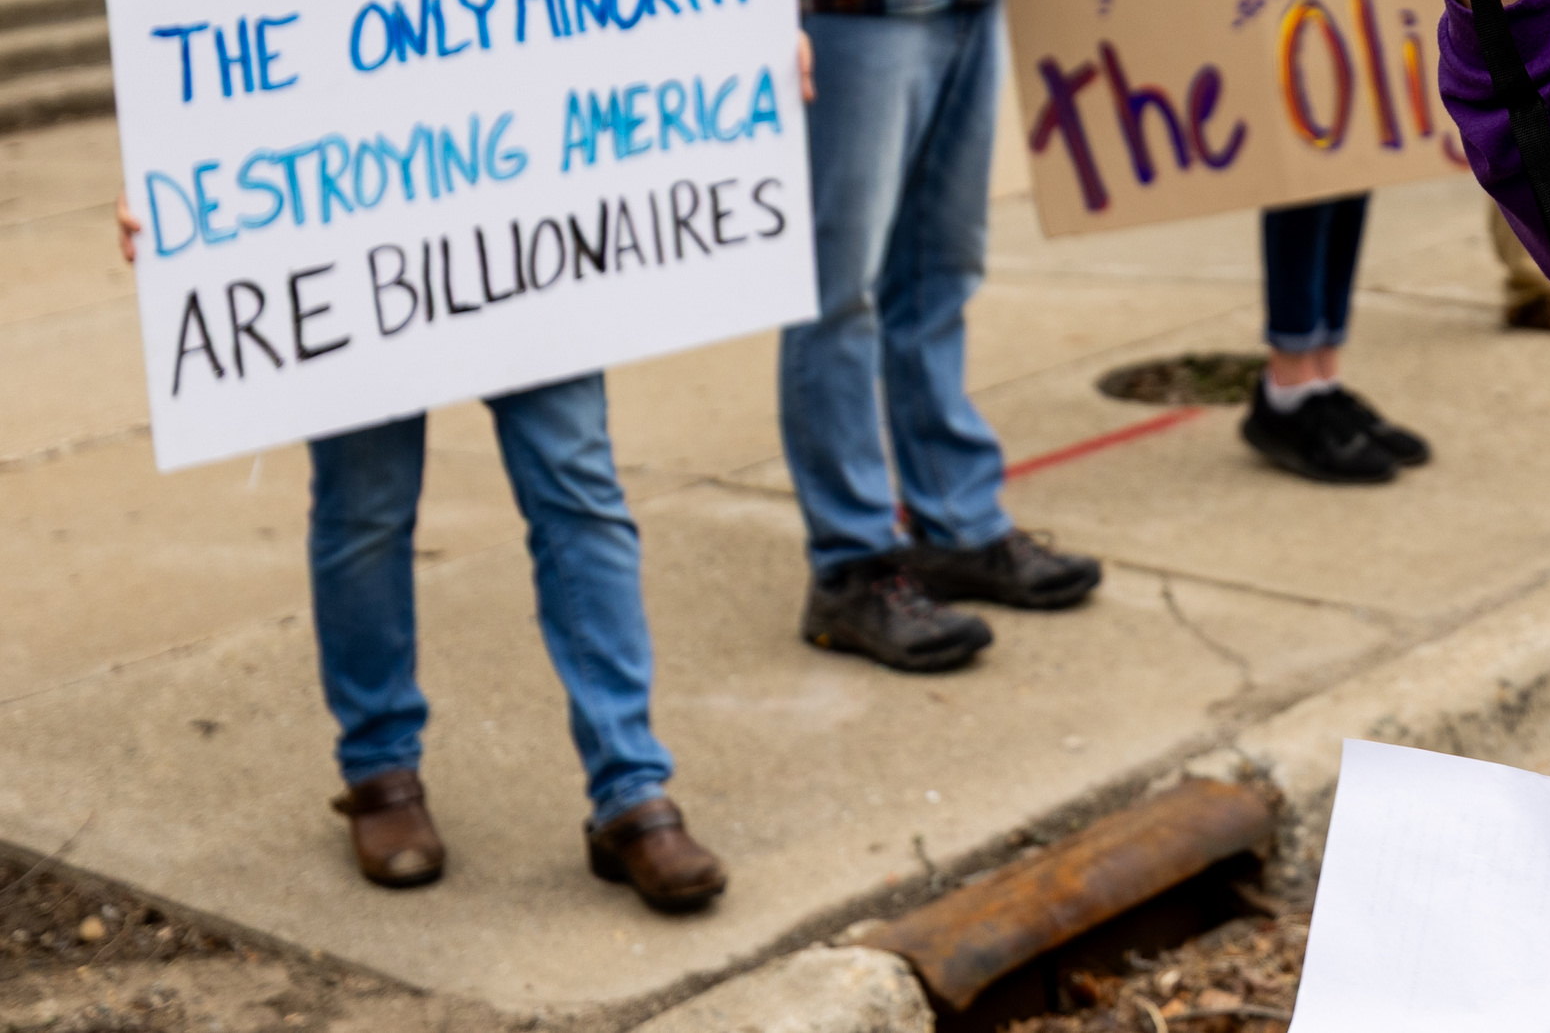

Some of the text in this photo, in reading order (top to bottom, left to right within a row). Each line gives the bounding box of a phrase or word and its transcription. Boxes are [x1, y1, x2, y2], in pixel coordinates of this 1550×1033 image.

[151, 13, 299, 103] THE
[1030, 40, 1247, 212] the
[144, 65, 784, 259] DESTROYING AMERICA
[171, 177, 787, 397] ARE BILLIONAIRES
